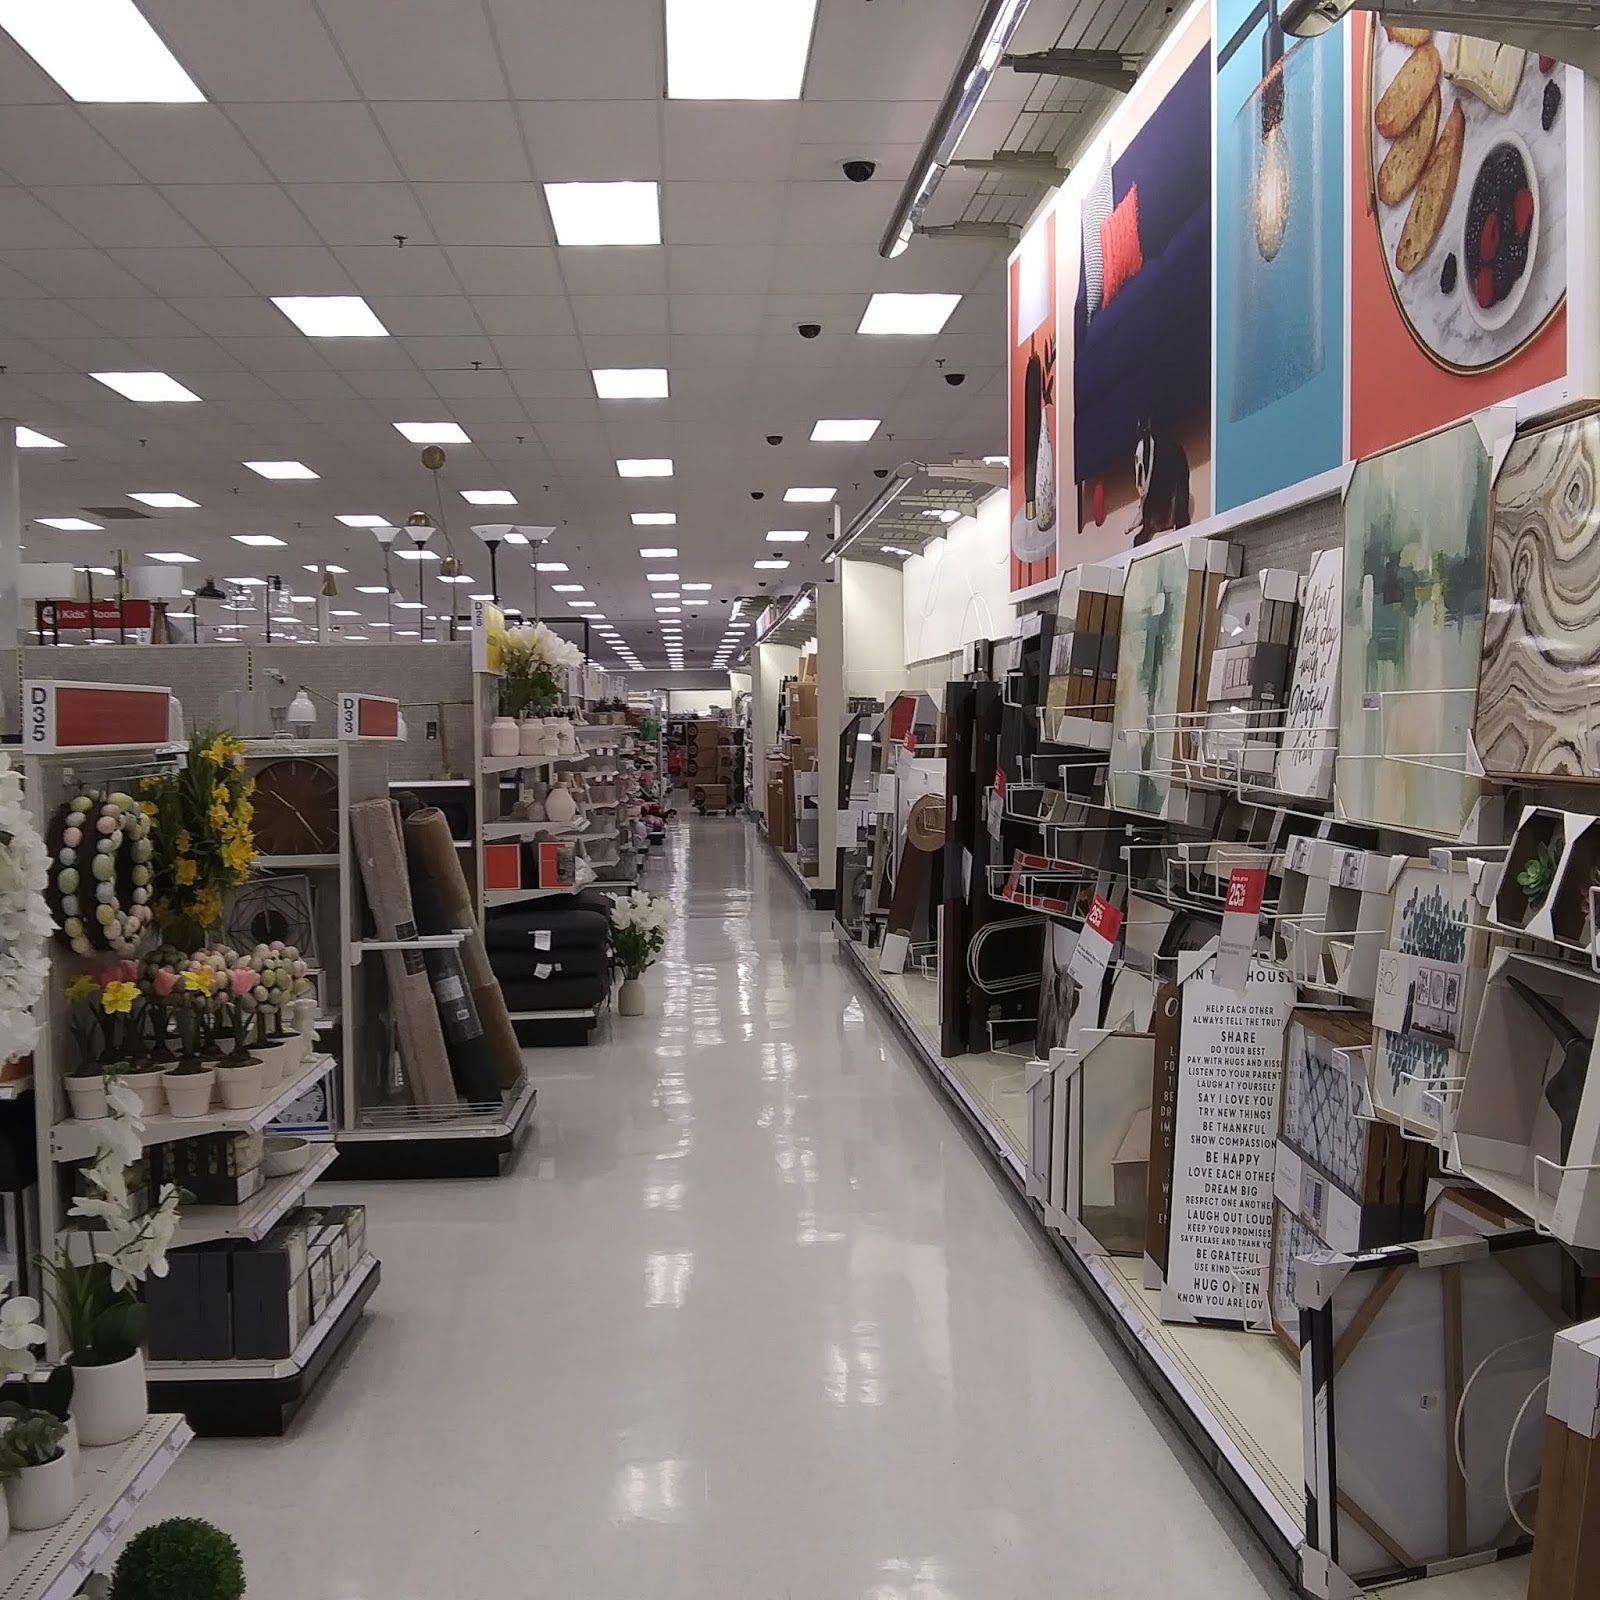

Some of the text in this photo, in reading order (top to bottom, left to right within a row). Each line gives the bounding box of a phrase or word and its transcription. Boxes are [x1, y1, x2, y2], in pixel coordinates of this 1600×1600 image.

[31, 687, 47, 742] D35
[343, 698, 354, 733] D33
[1249, 1007, 1273, 1015] OTHER
[1193, 1016, 1223, 1024] ALWAYS
[1226, 1017, 1242, 1025] TELL
[1246, 1018, 1259, 1026] THE
[1221, 1031, 1255, 1043] SHARE
[1188, 1056, 1201, 1064] PAY
[1204, 1057, 1222, 1065] WITH
[1225, 1058, 1244, 1066] HUGS
[1264, 1060, 1282, 1068] KISS
[1189, 1068, 1213, 1076] LISTEN
[1217, 1069, 1226, 1077] TO
[1229, 1070, 1250, 1078] YOUR
[1253, 1071, 1282, 1080] PARENT
[1197, 1080, 1222, 1088] LAUGH
[1237, 1082, 1276, 1091] YOURSELF
[1198, 1093, 1273, 1106] SAY I LOVE YOU
[1199, 1107, 1271, 1120] TRY NEW THINGS
[1203, 1122, 1265, 1134] BE THANKFUL
[1191, 1135, 1276, 1148] SHOW COMPASSION
[1206, 1152, 1260, 1165] BE HAPPY
[1189, 1167, 1212, 1178] LOVE
[1217, 1169, 1241, 1179] EACH
[1205, 1183, 1258, 1196] DREAM BIG
[1186, 1196, 1218, 1205] RESPECT
[1222, 1199, 1236, 1207] ONE
[1188, 1210, 1219, 1221] LAUGH
[1223, 1213, 1242, 1222] OUT
[1247, 1214, 1272, 1225] LOUD
[1188, 1224, 1270, 1237] KEEP YOUR PROMISES
[1196, 1236, 1219, 1244] PLEASE
[1222, 1238, 1235, 1246] AND
[1238, 1239, 1260, 1247] THANK
[1197, 1249, 1260, 1263] BE GRATEFUL
[1195, 1263, 1208, 1272] USE
[1211, 1264, 1229, 1273] KIND
[1194, 1278, 1259, 1295] HUG OFEN
[1178, 1293, 1263, 1309] KNOW YOU ARE LOV
